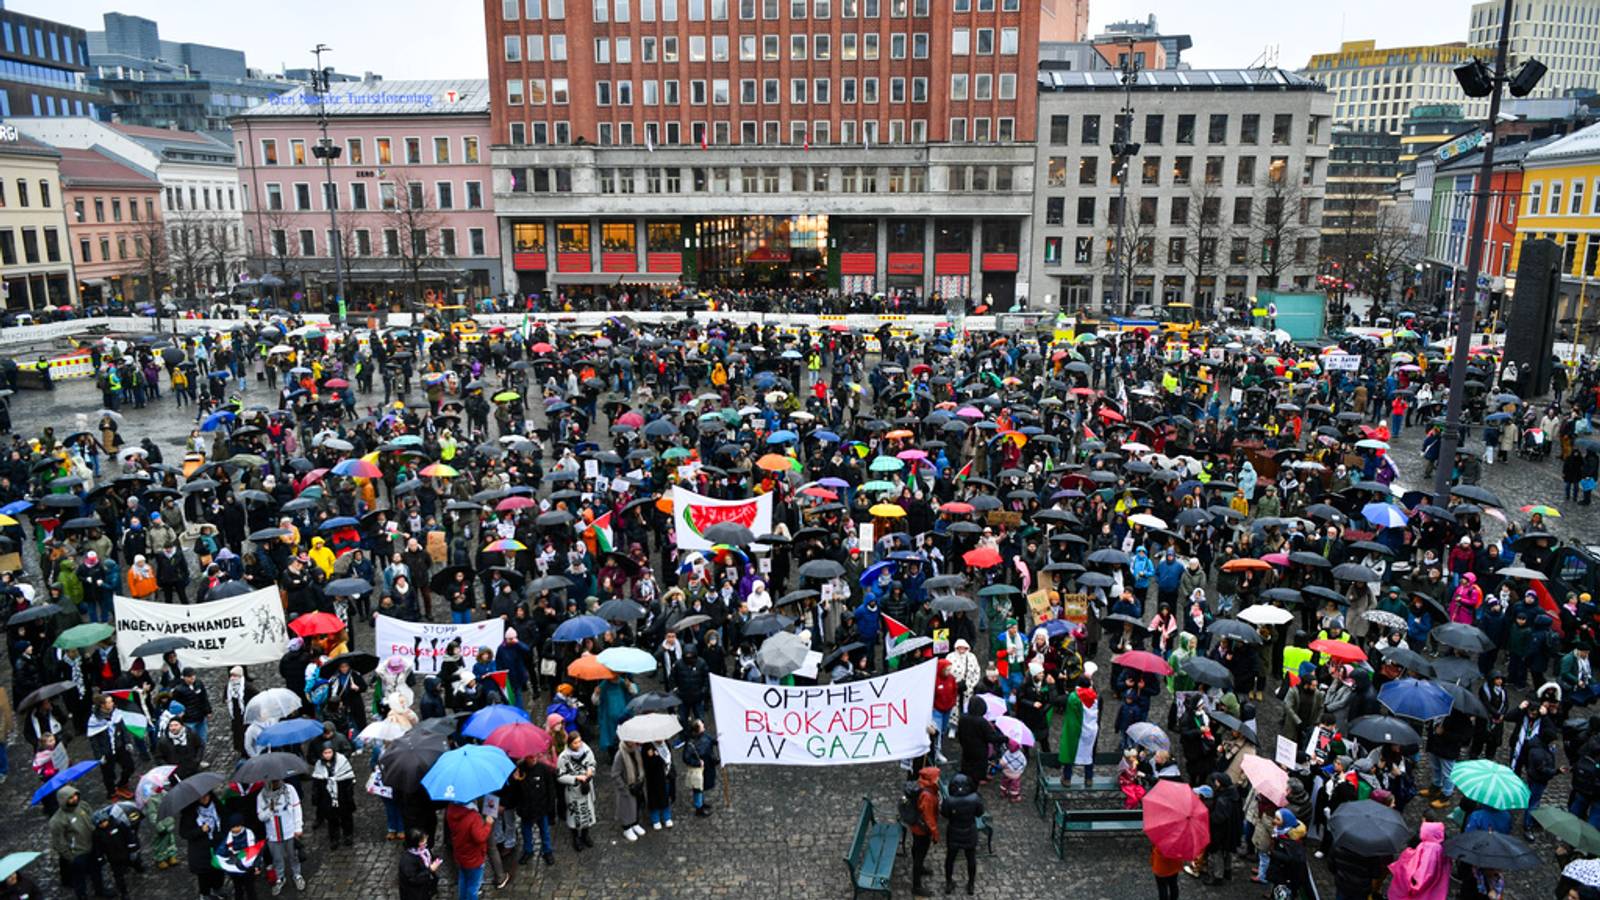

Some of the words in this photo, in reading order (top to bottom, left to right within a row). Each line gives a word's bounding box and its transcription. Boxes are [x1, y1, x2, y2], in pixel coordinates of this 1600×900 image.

[423, 625, 458, 635] STOPP
[763, 677, 889, 709] OPPHEV
[747, 735, 786, 759] AV
[806, 731, 891, 759] GAZA
